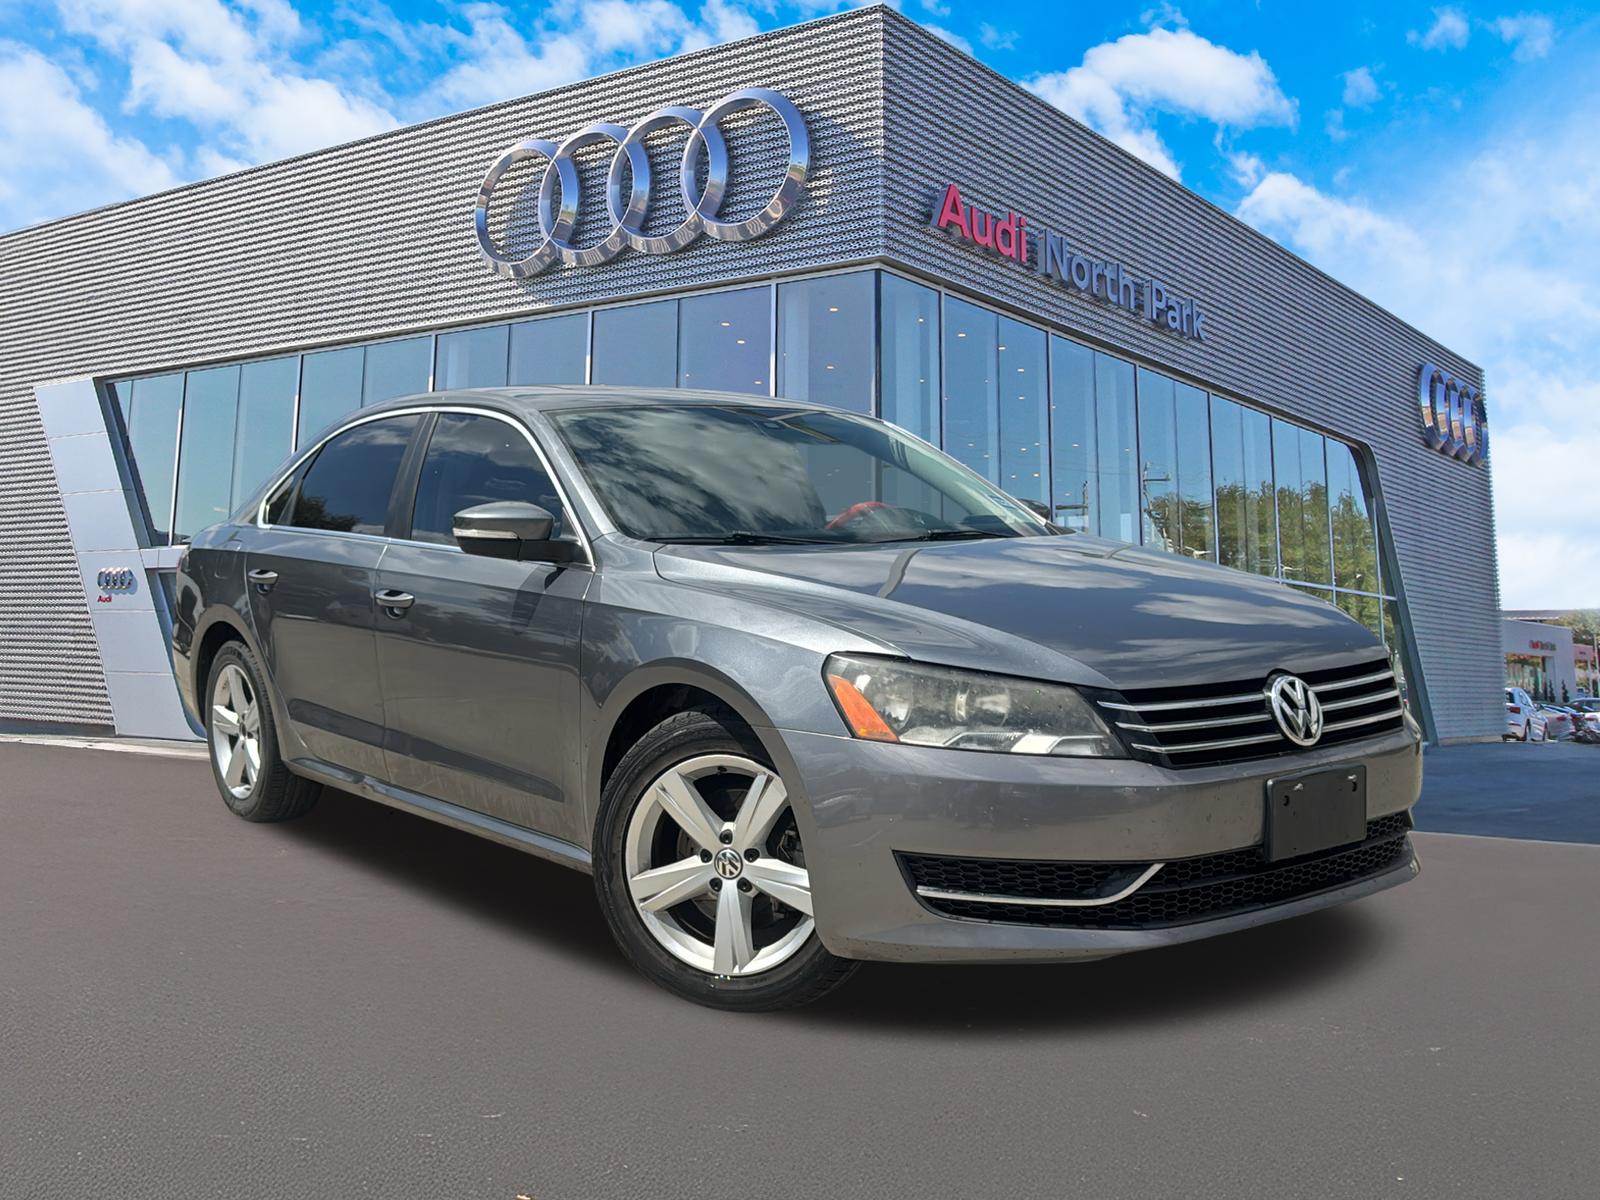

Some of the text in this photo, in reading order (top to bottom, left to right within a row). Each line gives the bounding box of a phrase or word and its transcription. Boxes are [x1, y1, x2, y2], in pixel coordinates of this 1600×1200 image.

[933, 183, 1208, 341] Audi North Park
